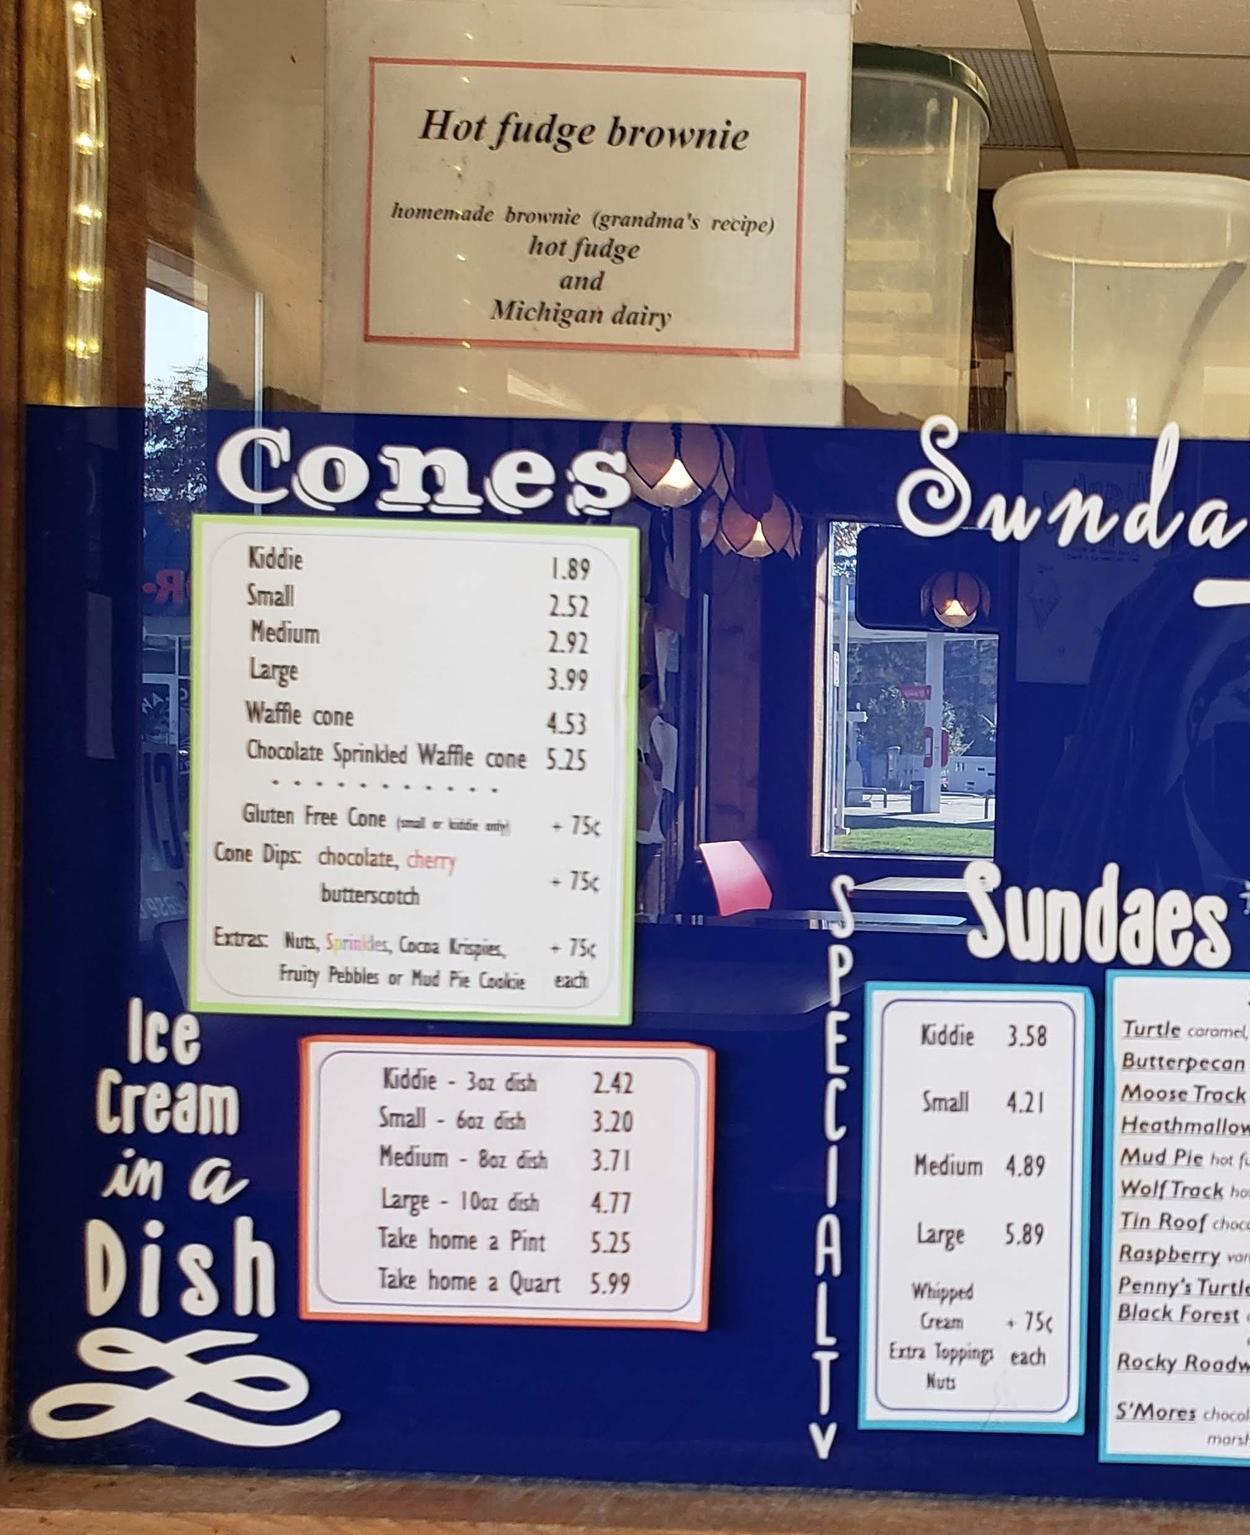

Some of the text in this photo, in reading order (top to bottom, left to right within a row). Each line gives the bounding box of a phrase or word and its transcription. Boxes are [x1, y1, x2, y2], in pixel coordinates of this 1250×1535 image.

[418, 109, 750, 153] Hot fudge brownie
[391, 202, 774, 237] homemade brownie (grandma's recipe)
[529, 235, 640, 264] hot fudge
[560, 270, 605, 291] and
[490, 299, 672, 332] Michigan dairy
[216, 427, 632, 516] Cones
[249, 546, 590, 580] Kiddie 1.89
[247, 583, 589, 618] Small 2.52
[251, 619, 588, 654] Medium 2.92
[250, 657, 588, 691] Large 3.99
[245, 700, 586, 735] Waffle cone 4.53
[246, 739, 586, 771] Chocolate Sprinkled Waffle cone 5.25
[213, 841, 455, 875] Cone Dips: chocolate, cherry
[963, 860, 1232, 968] Sundaes
[128, 997, 200, 1065] Ice
[921, 1023, 1047, 1047] Kiddie 3.58
[1123, 1020, 1181, 1040] Turtle
[1188, 1025, 1248, 1040] caramel,
[1121, 1052, 1245, 1074] Butterpecan
[96, 1068, 240, 1136] Cream
[923, 1090, 1043, 1113] Small 4.21
[101, 1147, 249, 1205] in a
[915, 1153, 1045, 1177] Medium 4.89
[382, 1187, 429, 1217] Large
[462, 1191, 498, 1211] 10oz
[508, 1192, 539, 1212] dish
[591, 1191, 631, 1214] 4.77
[918, 1222, 1044, 1250] Large 5.89
[84, 1215, 276, 1318] Dish
[1119, 1244, 1221, 1268] Raspberry
[378, 1267, 630, 1296] Take home a Quart 5.99
